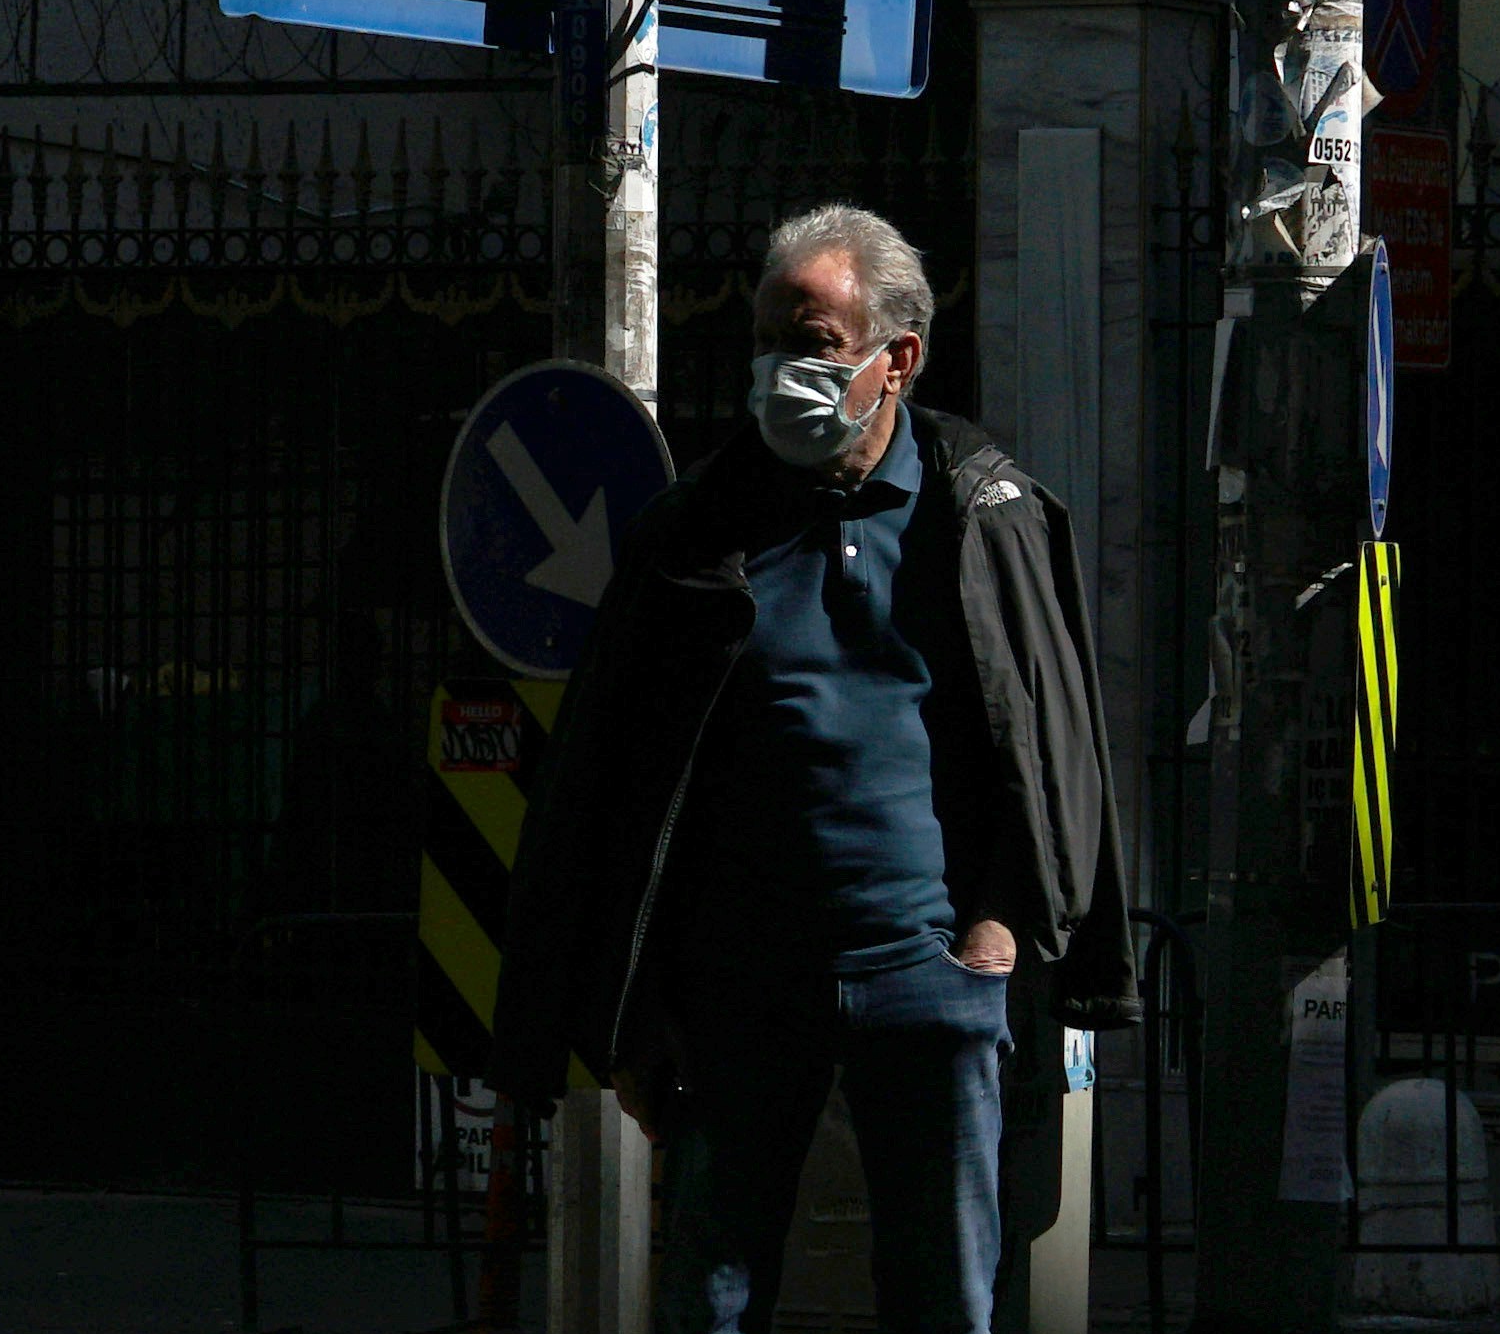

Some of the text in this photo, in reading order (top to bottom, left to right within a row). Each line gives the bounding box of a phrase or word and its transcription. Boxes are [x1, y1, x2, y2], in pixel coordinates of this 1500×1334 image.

[1313, 136, 1353, 163] 0552
[1303, 998, 1347, 1021] PAR
[455, 1127, 494, 1146] PAR
